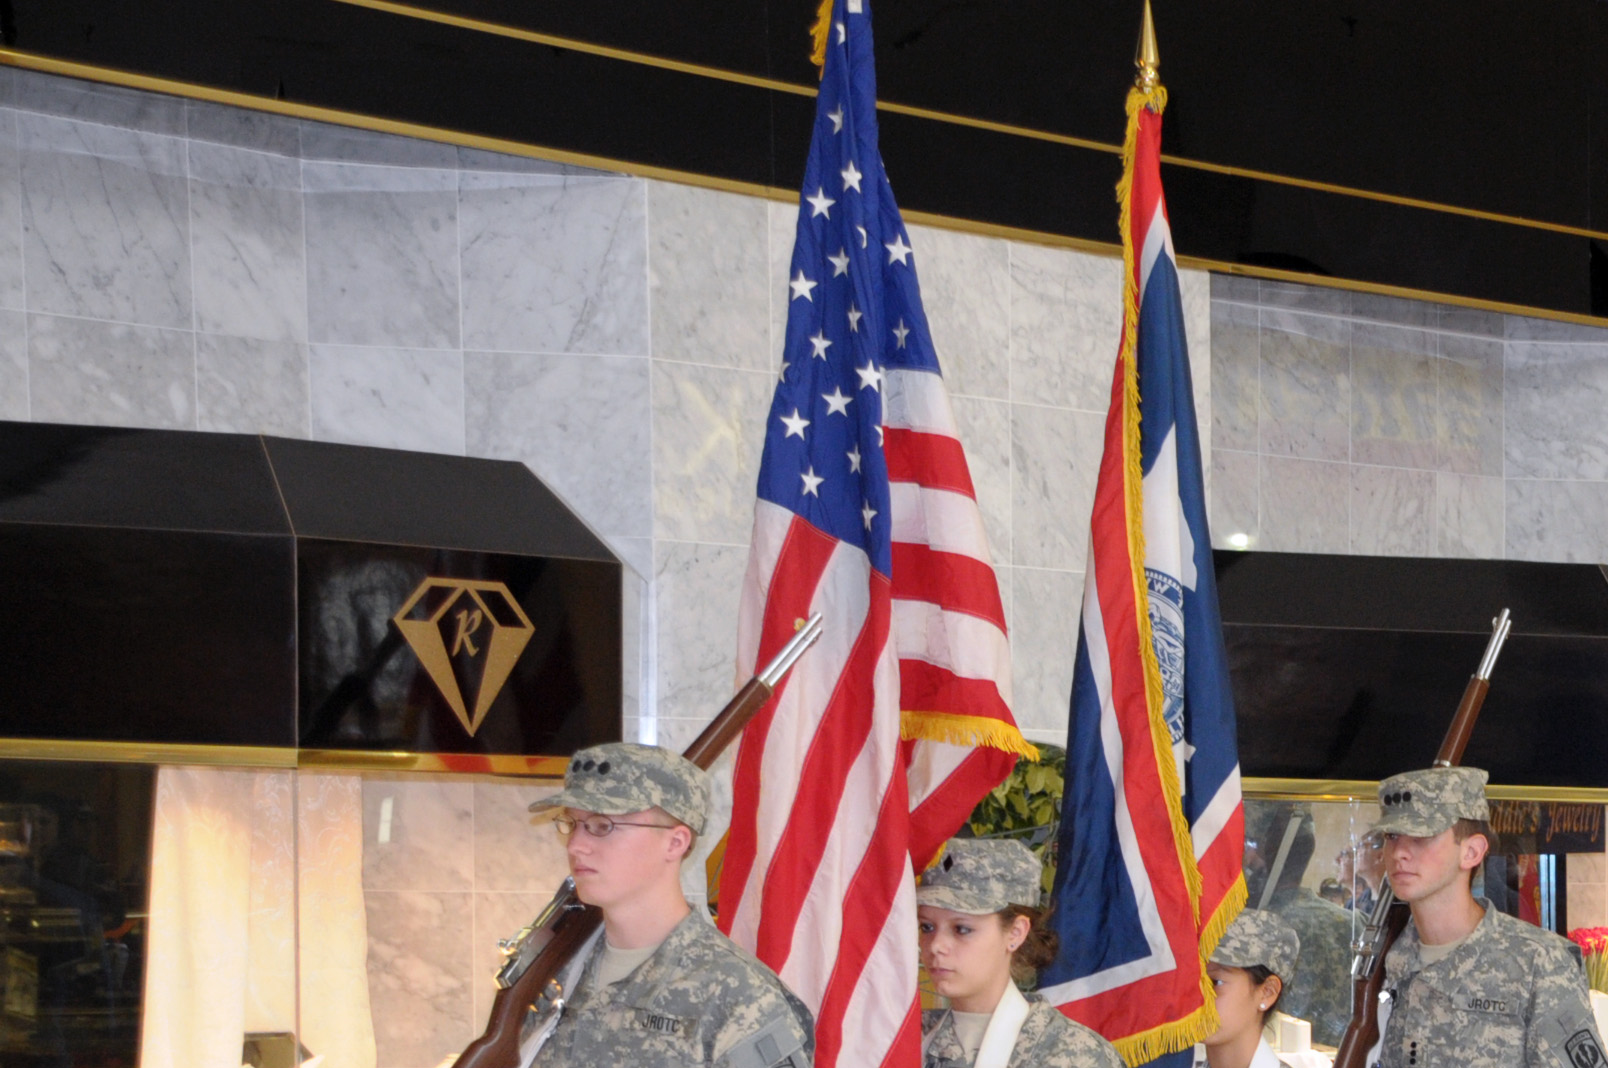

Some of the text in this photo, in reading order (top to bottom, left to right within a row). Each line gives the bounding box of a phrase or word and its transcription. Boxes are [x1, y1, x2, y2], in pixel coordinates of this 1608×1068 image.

[451, 609, 483, 658] R
[1467, 998, 1507, 1012] JROTC
[641, 1014, 680, 1033] JROTC
